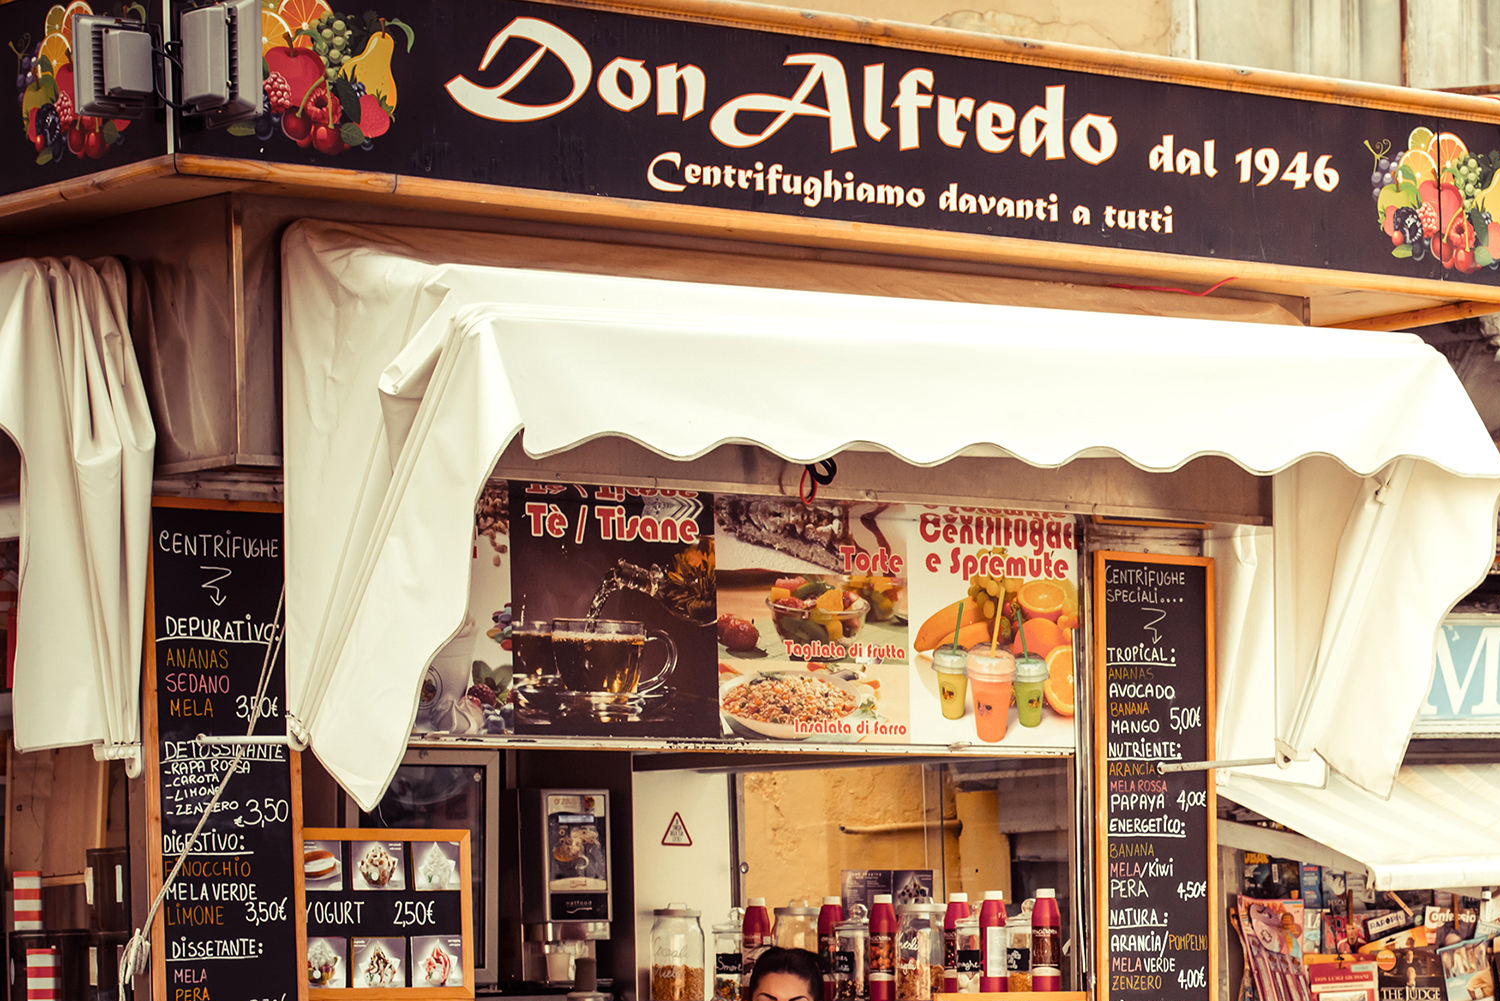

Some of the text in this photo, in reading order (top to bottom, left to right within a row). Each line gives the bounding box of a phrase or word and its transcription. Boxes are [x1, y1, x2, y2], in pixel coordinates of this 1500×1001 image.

[445, 16, 1340, 193] Don Alfredo dal 1946
[647, 152, 1173, 234] Centrifughiamo davanti a tutti
[525, 502, 568, 538] Tè
[595, 505, 700, 544] Tisane
[840, 546, 903, 573] Torte
[925, 547, 1069, 580] e Spremute
[166, 648, 229, 669] ANANAS
[784, 641, 905, 660] Tagliata di frutta
[165, 673, 230, 694] SEDANO
[1108, 667, 1155, 681] ANANAS
[1109, 683, 1176, 700] AVOCADO
[170, 698, 214, 718] MELA
[1110, 701, 1150, 717] BANANA
[794, 719, 907, 735] Insalata di farro
[1111, 719, 1160, 734] MANGO
[1109, 760, 1156, 776] ARANCIA
[1110, 779, 1168, 794] MELA ROSSA
[1110, 794, 1165, 813] PAPAYA
[1109, 843, 1154, 859] BANANA
[165, 882, 258, 901] MELA VERDE
[1110, 879, 1149, 898] PERA
[167, 897, 288, 926] LIMONE 3,50€
[393, 900, 436, 927] 2,50€
[1112, 957, 1176, 973] MELA VERDE
[174, 968, 208, 984] MELA
[1112, 975, 1162, 991] ZENZERO
[1381, 986, 1441, 1001] THE JUDGE
